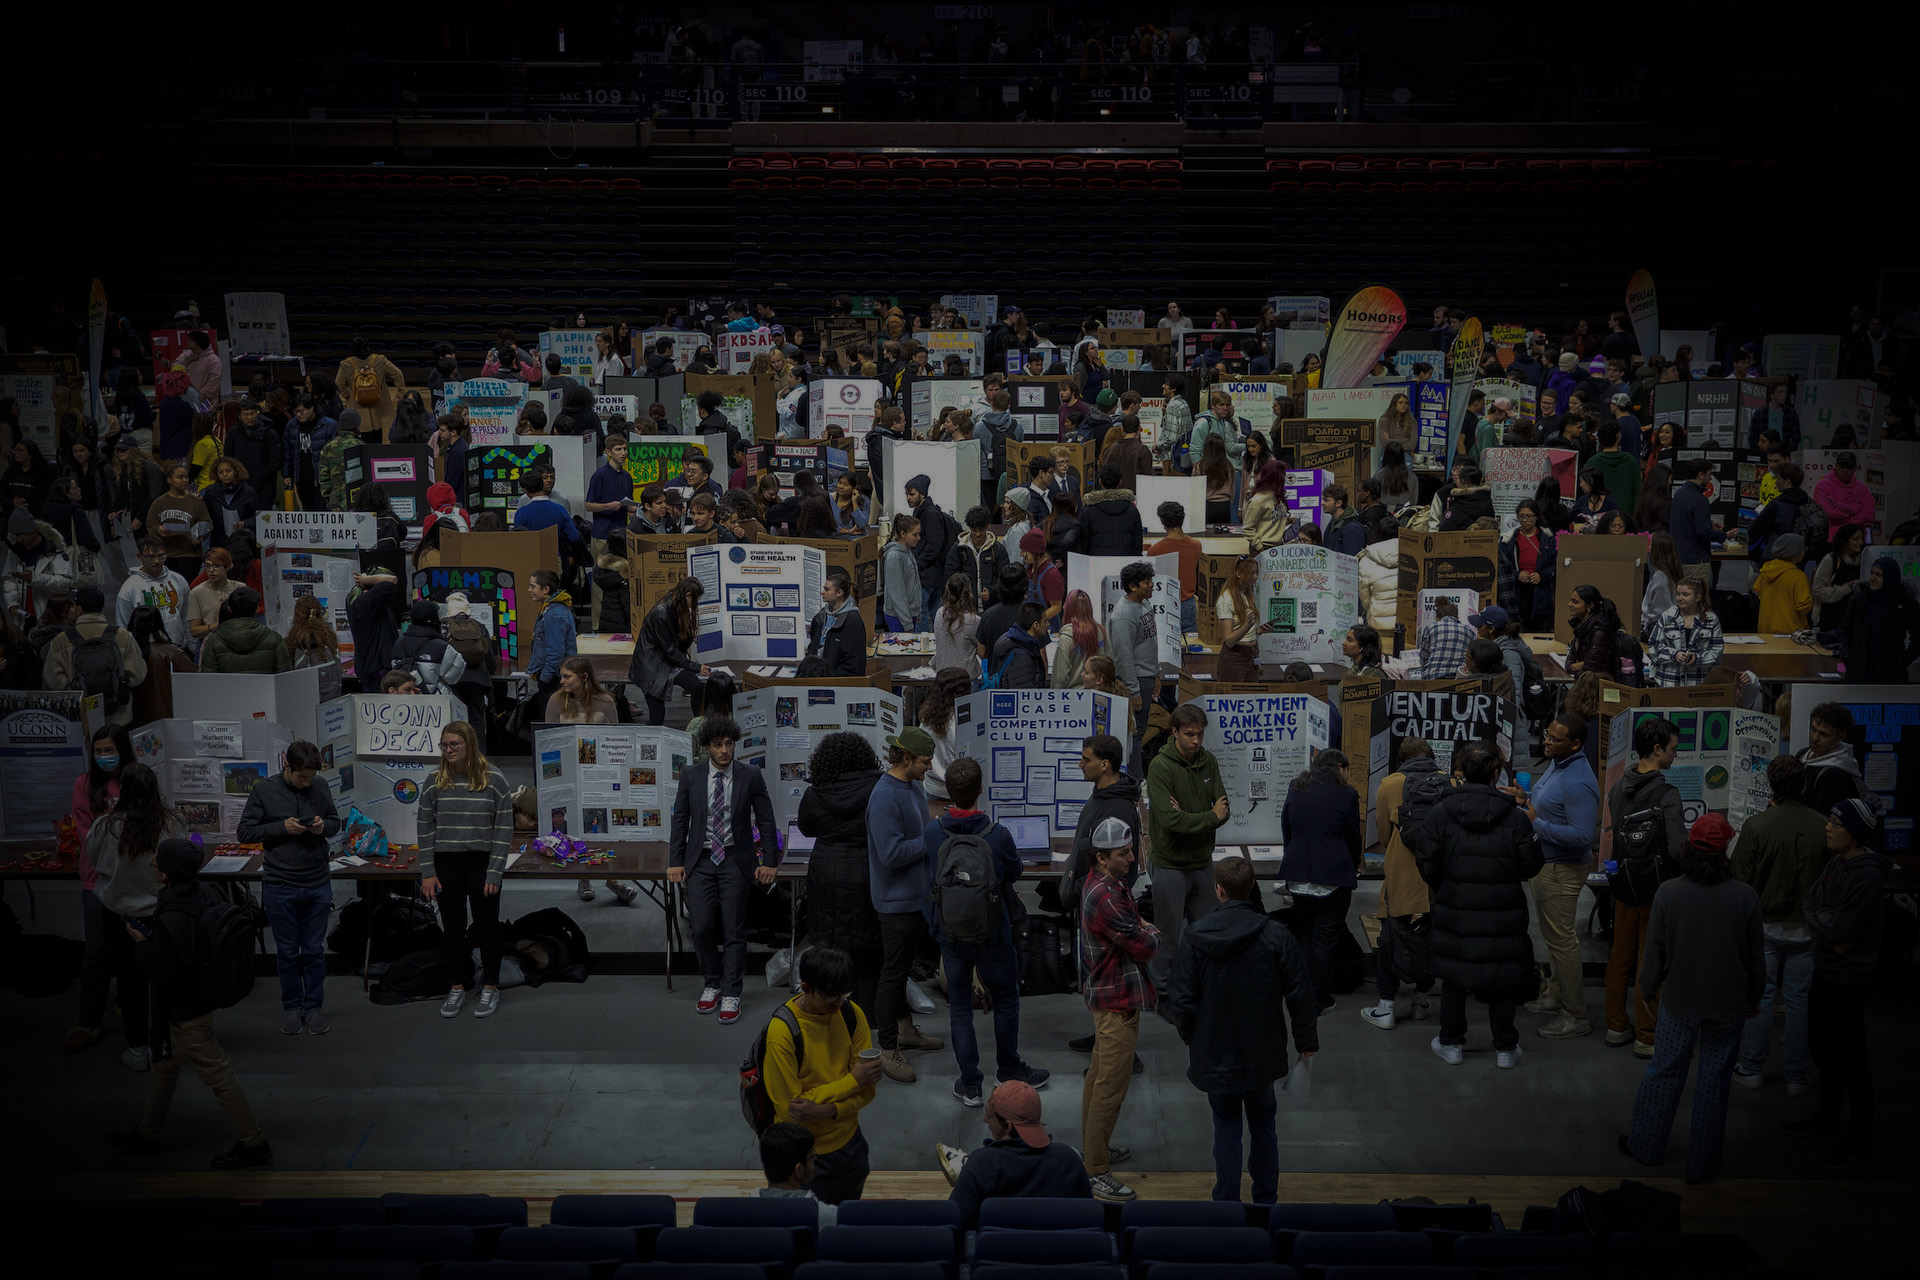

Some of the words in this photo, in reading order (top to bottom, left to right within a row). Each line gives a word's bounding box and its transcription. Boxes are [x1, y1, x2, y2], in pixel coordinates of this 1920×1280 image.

[961, 6, 991, 18] 210
[585, 89, 622, 105] 109
[664, 88, 685, 98] SEC
[745, 88, 767, 98] SEC
[776, 86, 807, 101] 110
[1090, 88, 1112, 98] SEC
[1120, 86, 1152, 101] 110
[1189, 88, 1210, 97] SEC
[1346, 309, 1403, 324] HONORS
[556, 333, 592, 343] ALPHA
[564, 345, 584, 354] PHI
[1400, 354, 1439, 366] UNICEF
[14, 378, 42, 388] active
[1228, 382, 1267, 392] UCONN
[15, 388, 44, 399] minds
[1312, 392, 1336, 402] ALPHA
[1344, 391, 1374, 400] LAMBDA
[1697, 394, 1729, 404] NRHH
[1307, 428, 1340, 436] BOARD
[1342, 428, 1358, 436] KIT
[1304, 454, 1334, 468] BOARD
[1336, 449, 1350, 460] KIT
[277, 513, 344, 524] REVOLUTION
[264, 528, 304, 540] AGAINST
[331, 529, 358, 540] RAPE
[1281, 546, 1314, 558] UCONN
[1266, 558, 1308, 571] CANNABIS
[1309, 558, 1328, 570] CLUB
[432, 570, 494, 590] NAMI
[1457, 572, 1474, 580] Display
[1022, 691, 1085, 701] HUSKY
[1344, 690, 1368, 700] BOARD
[1368, 688, 1380, 696] KIT
[1022, 704, 1072, 714] CASE
[1206, 697, 1308, 714] INVESTMENT
[360, 702, 442, 728] UCONN
[1219, 713, 1297, 729] BANKING
[8, 723, 66, 736] UCONN
[990, 719, 1088, 729] COMPETITION
[1391, 718, 1482, 742] CAPITAL
[1735, 716, 1779, 732] Entrepreneur
[202, 734, 234, 742] Marketing
[370, 728, 434, 753] DECA
[990, 732, 1038, 741] CLUB
[1223, 728, 1298, 745] SOCIETY
[1735, 726, 1777, 744] Opportunities
[398, 762, 424, 770] DECA
[1248, 763, 1271, 772] UIBS
